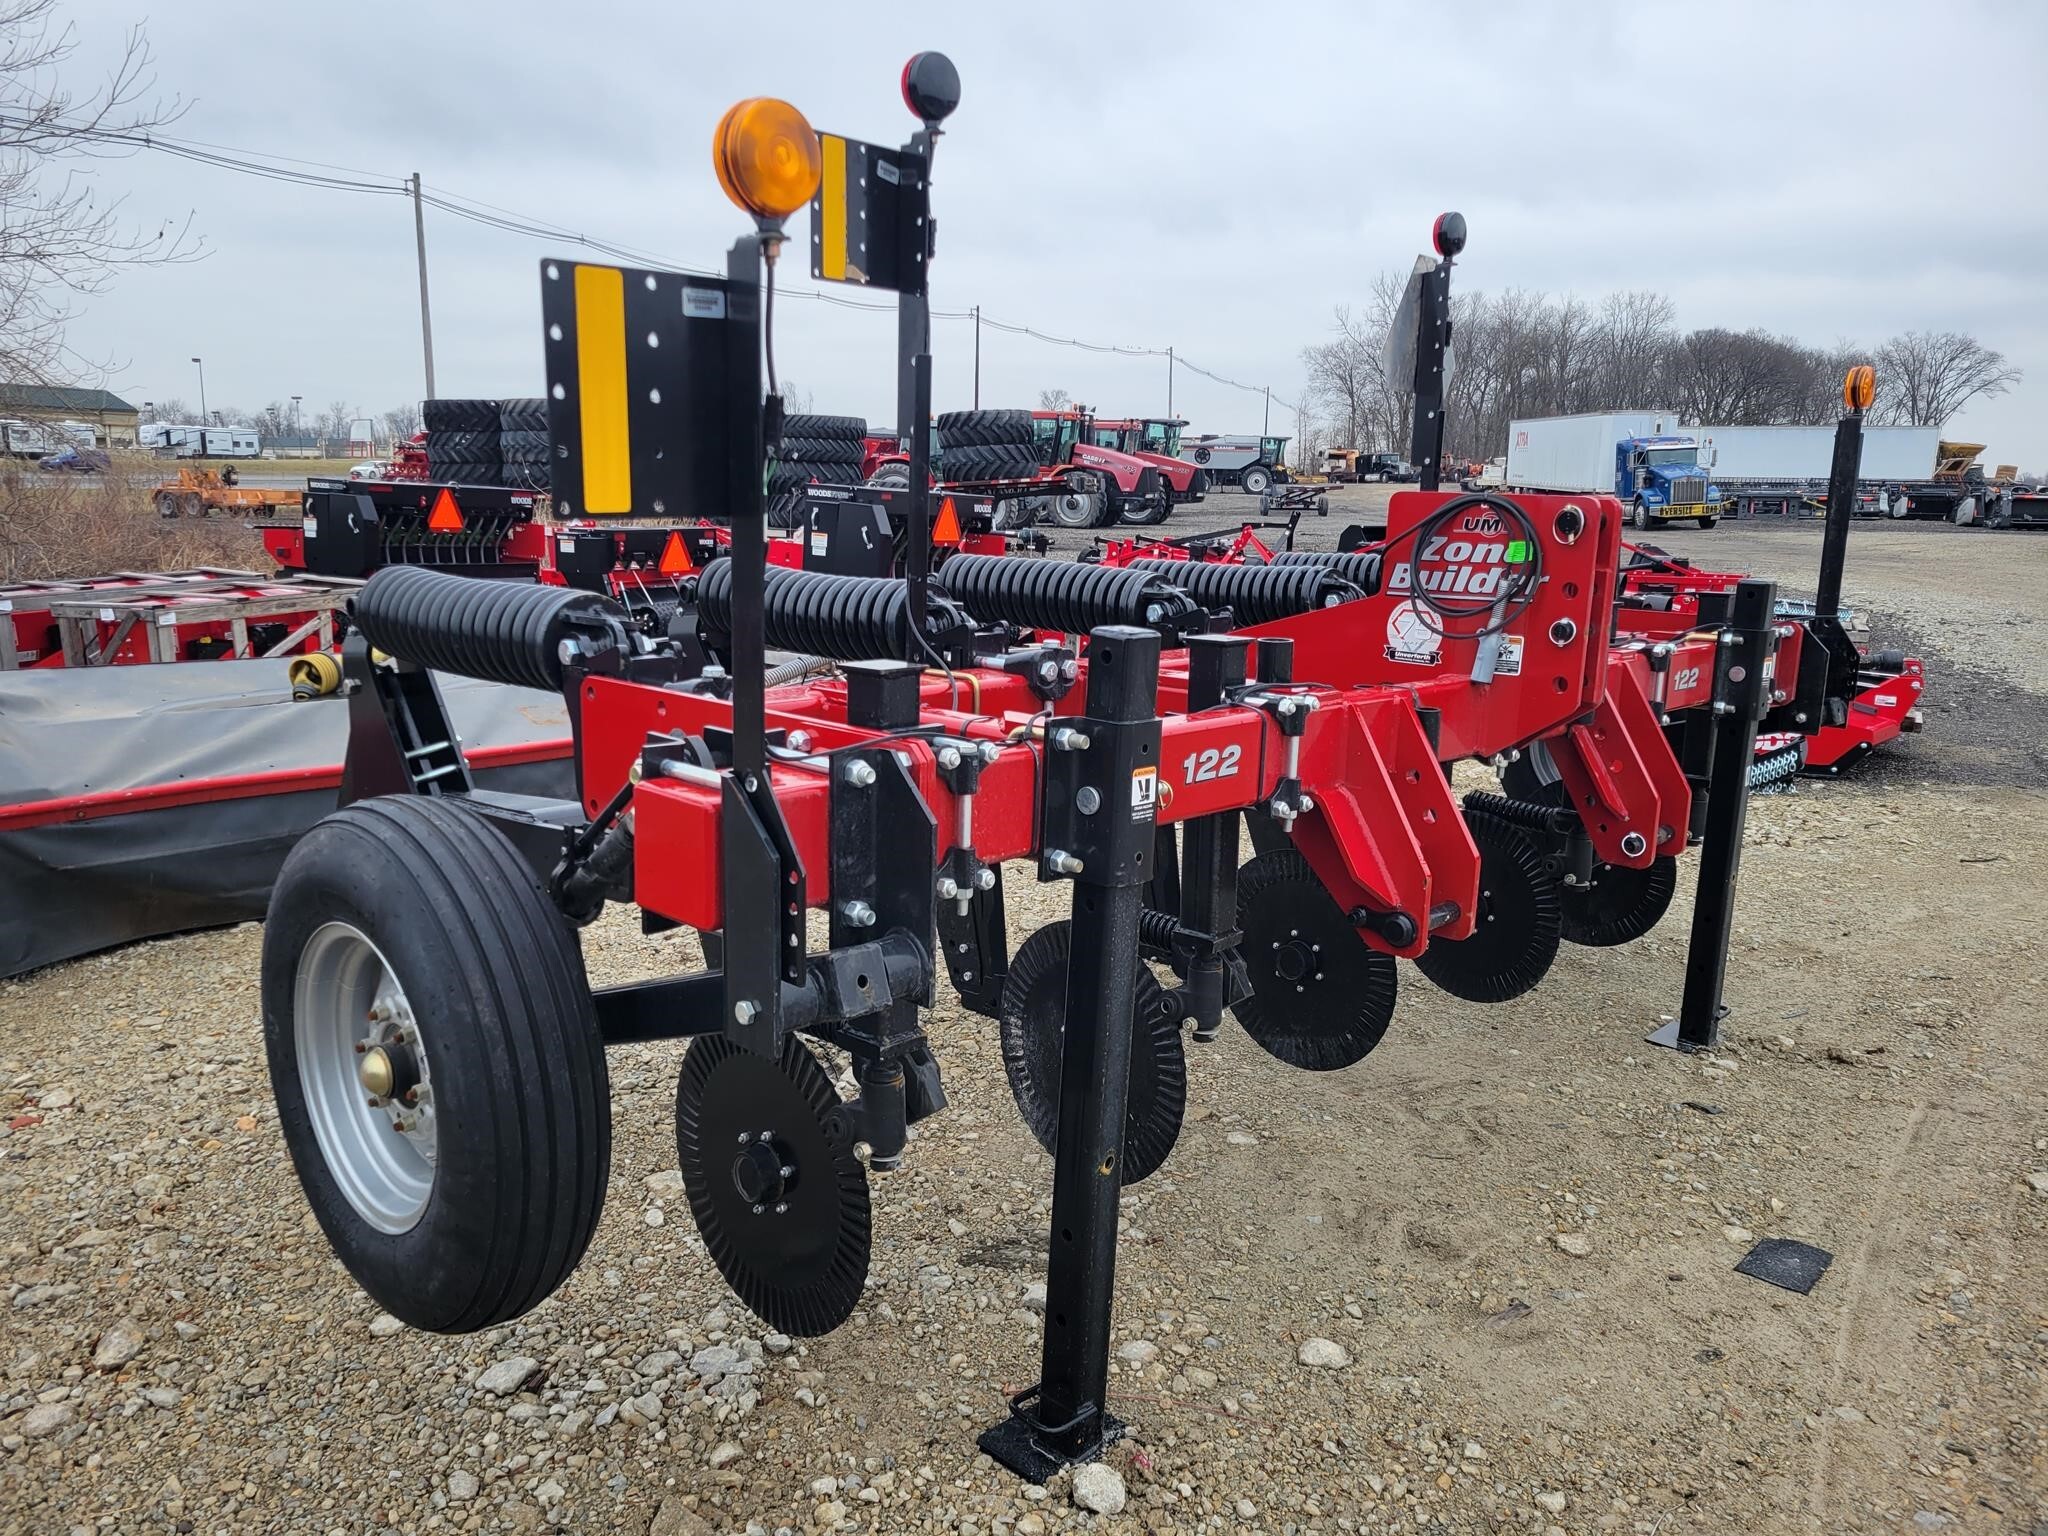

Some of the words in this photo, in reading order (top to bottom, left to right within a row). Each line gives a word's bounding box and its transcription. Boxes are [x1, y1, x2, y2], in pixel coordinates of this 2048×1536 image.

[808, 488, 832, 497] WOODS
[510, 496, 533, 504] WOODS
[1660, 505, 1692, 516] OVERSIZE
[1463, 517, 1502, 533] UM
[1673, 667, 1700, 691] 122
[1183, 744, 1242, 785] 122
